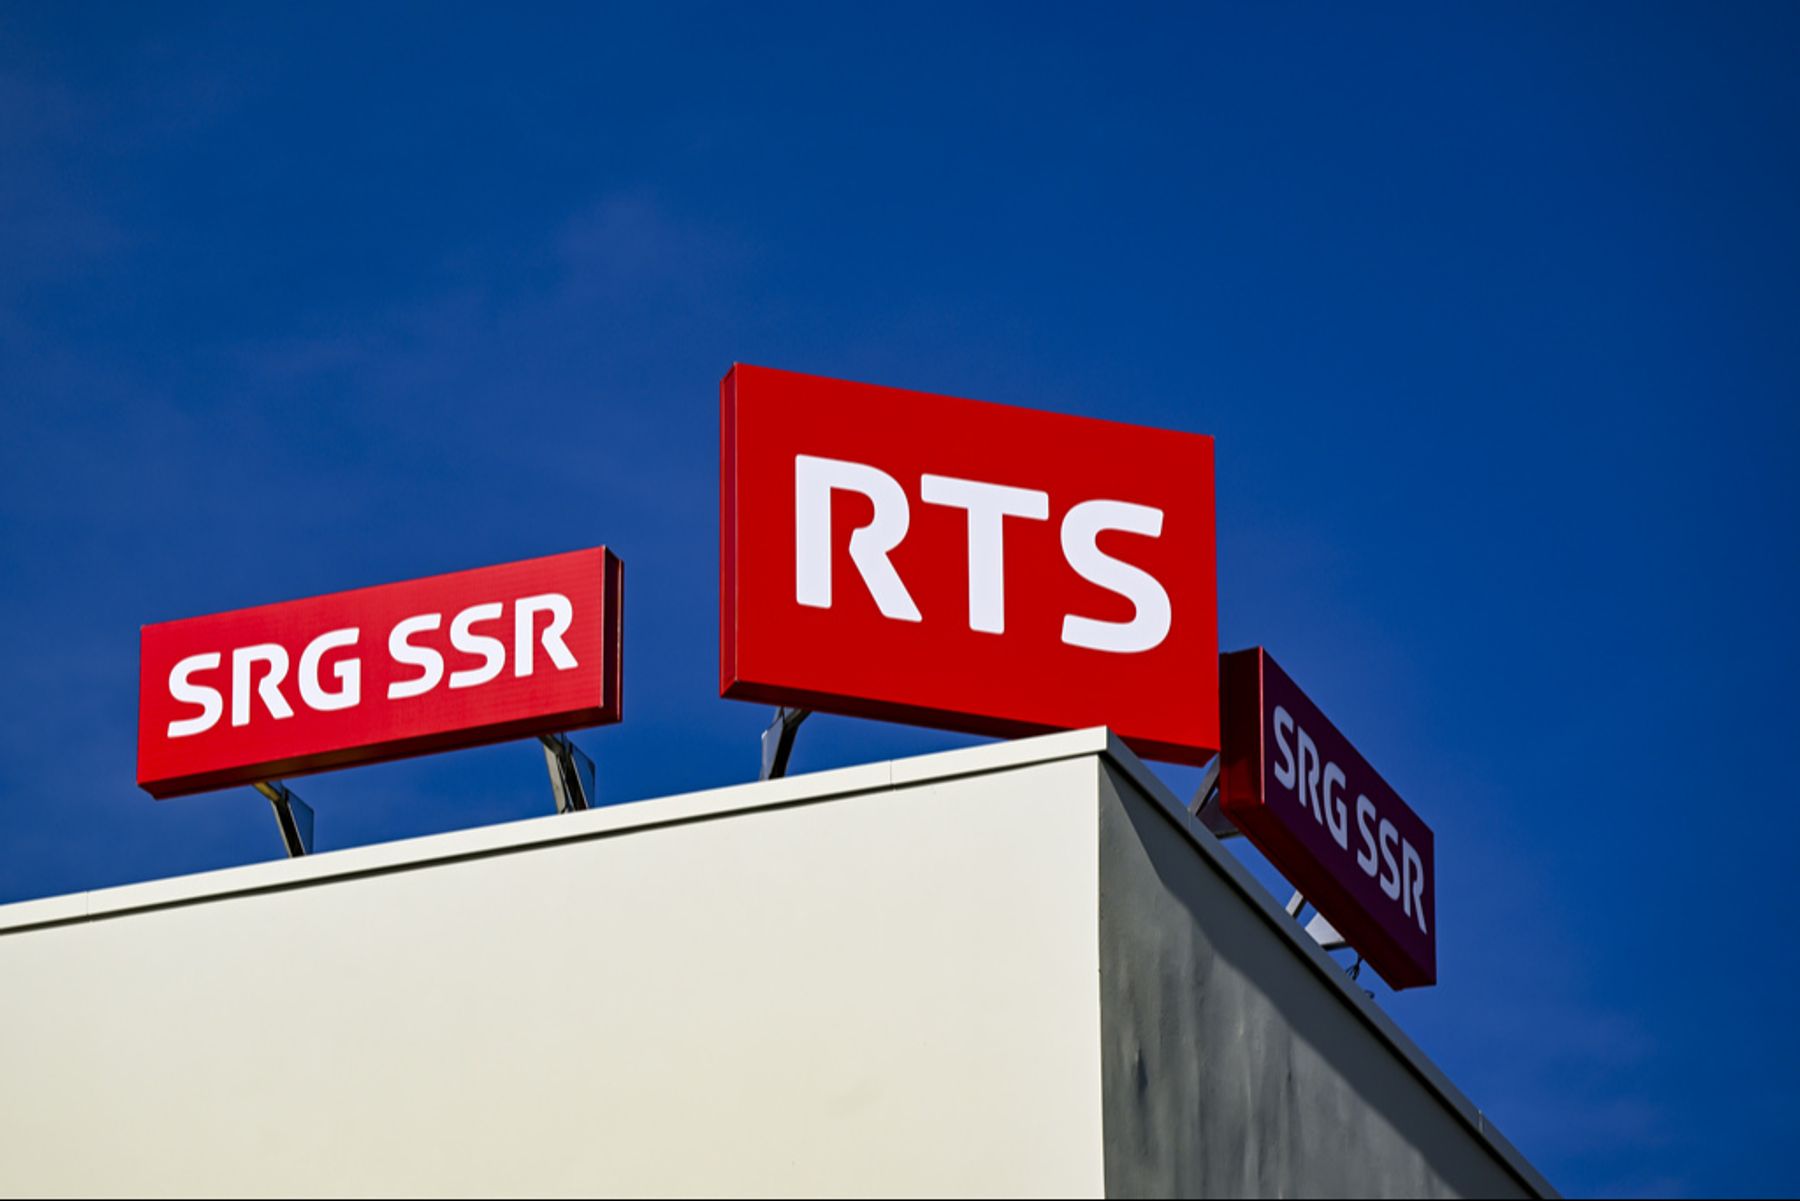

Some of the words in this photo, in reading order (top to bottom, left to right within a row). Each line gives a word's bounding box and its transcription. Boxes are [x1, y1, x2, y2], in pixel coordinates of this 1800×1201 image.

[795, 454, 1172, 653] RTS
[167, 627, 361, 738] SRG
[387, 593, 579, 700] SSR
[1274, 705, 1348, 850] SRG
[1357, 794, 1427, 934] SSR
